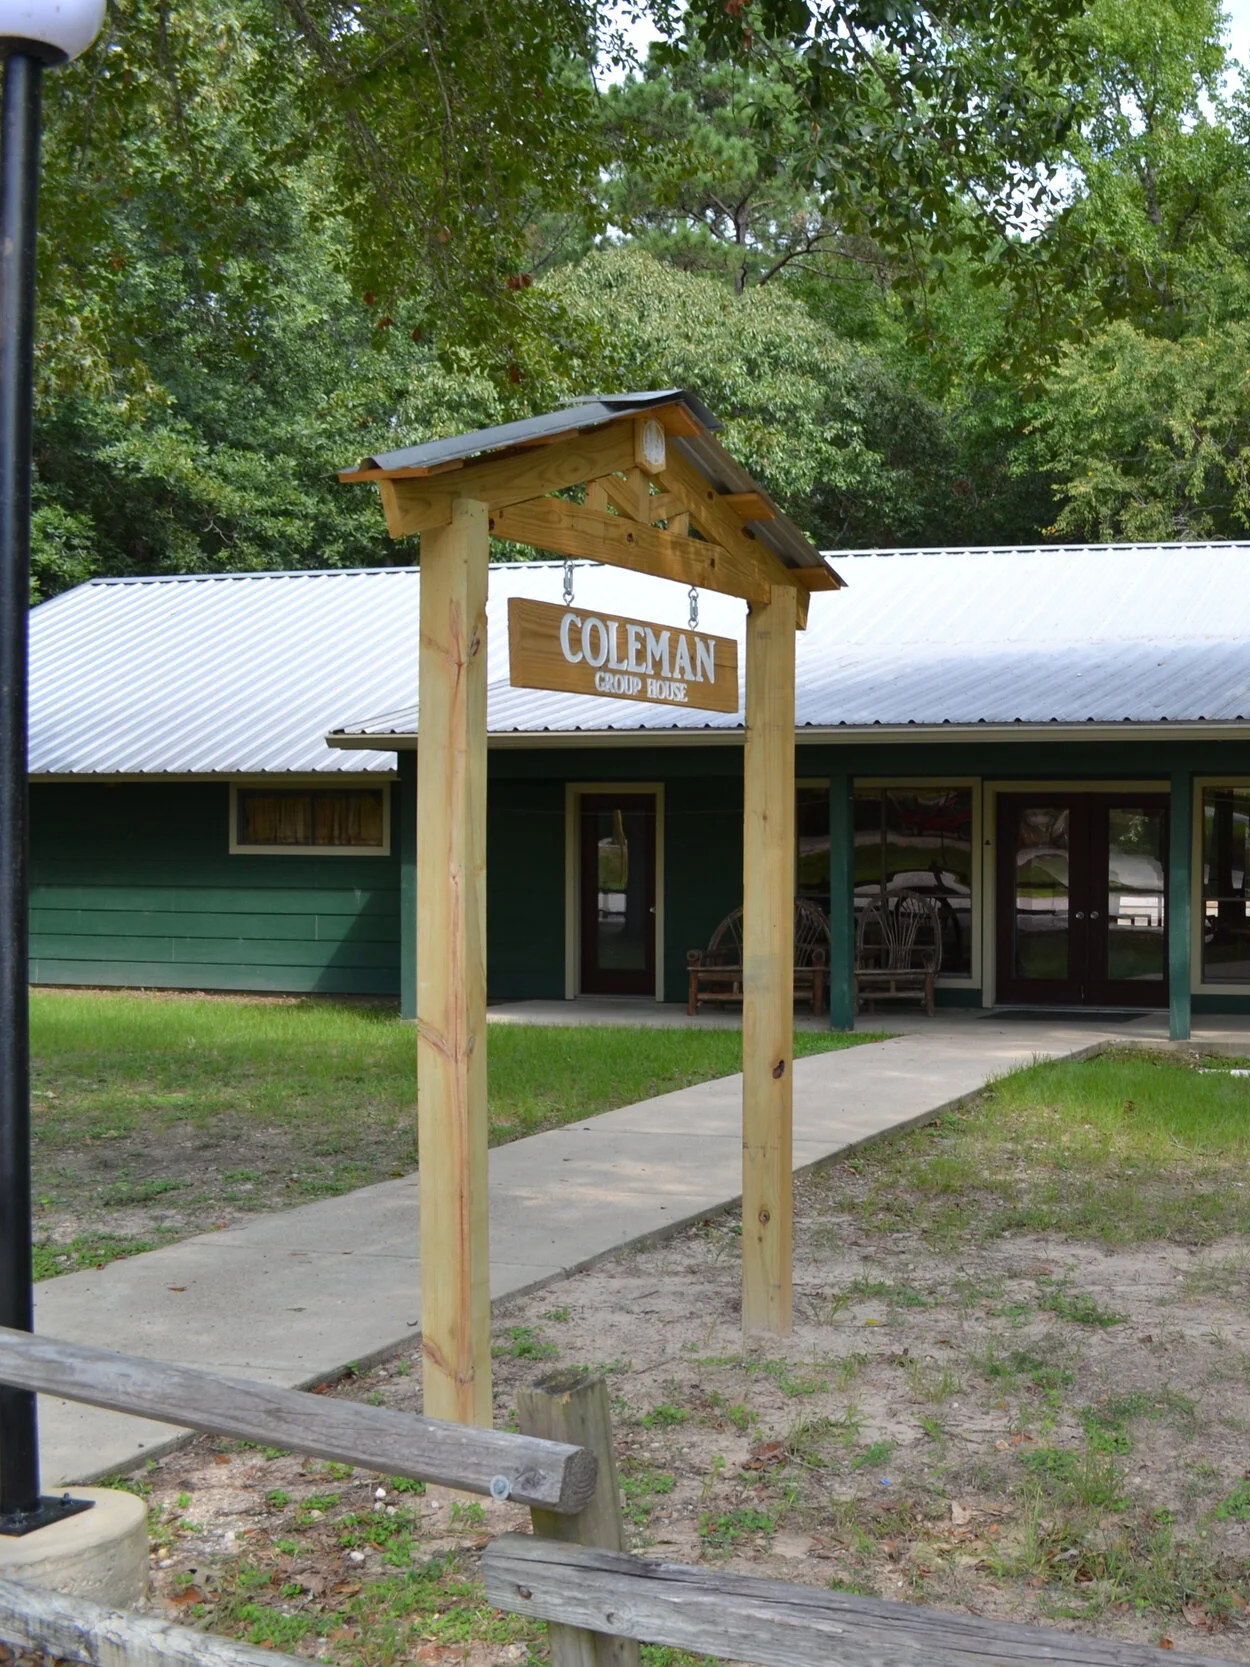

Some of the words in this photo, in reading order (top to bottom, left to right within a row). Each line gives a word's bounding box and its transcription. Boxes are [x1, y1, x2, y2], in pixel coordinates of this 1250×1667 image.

[560, 612, 715, 684] COLEMAN
[595, 671, 641, 696] GROUP
[647, 678, 688, 702] HOUSE
